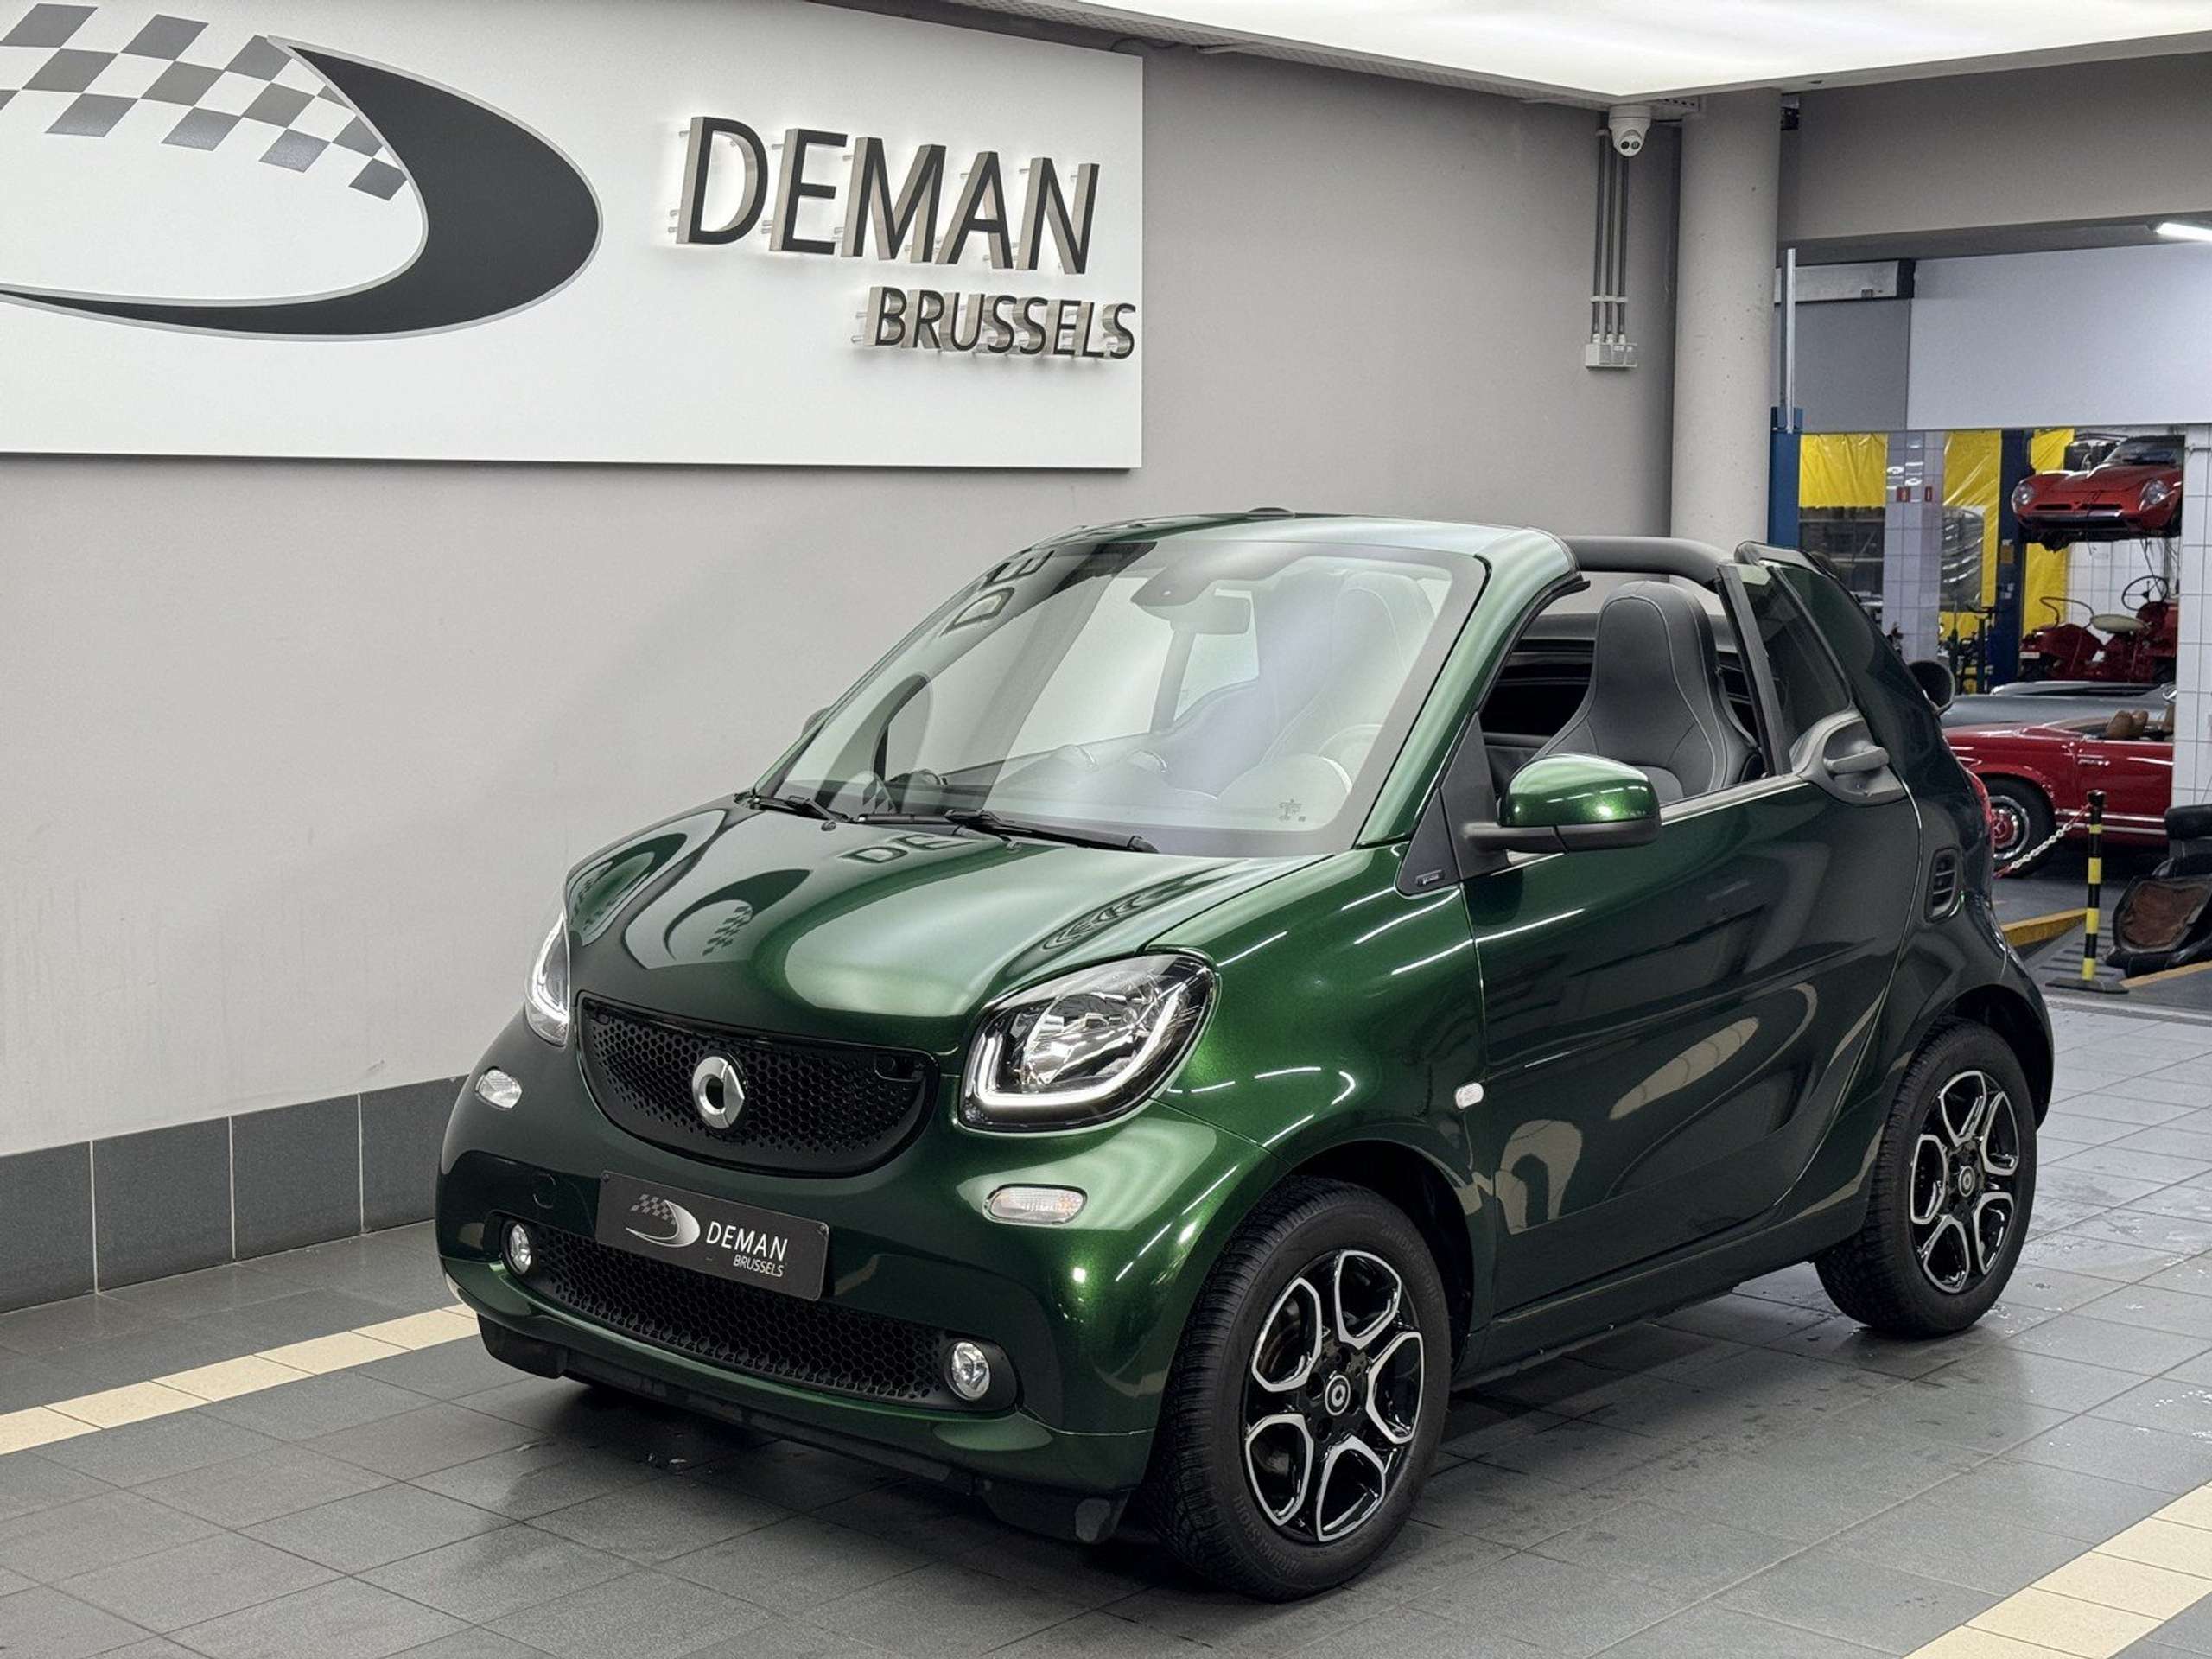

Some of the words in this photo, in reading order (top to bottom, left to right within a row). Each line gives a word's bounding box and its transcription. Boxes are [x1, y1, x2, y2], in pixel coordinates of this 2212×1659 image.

[676, 116, 1100, 275] DEMAN
[864, 286, 1136, 360] BRUSSELS
[706, 1221, 788, 1262] DEMAN
[733, 1254, 785, 1278] BRUSSELS
